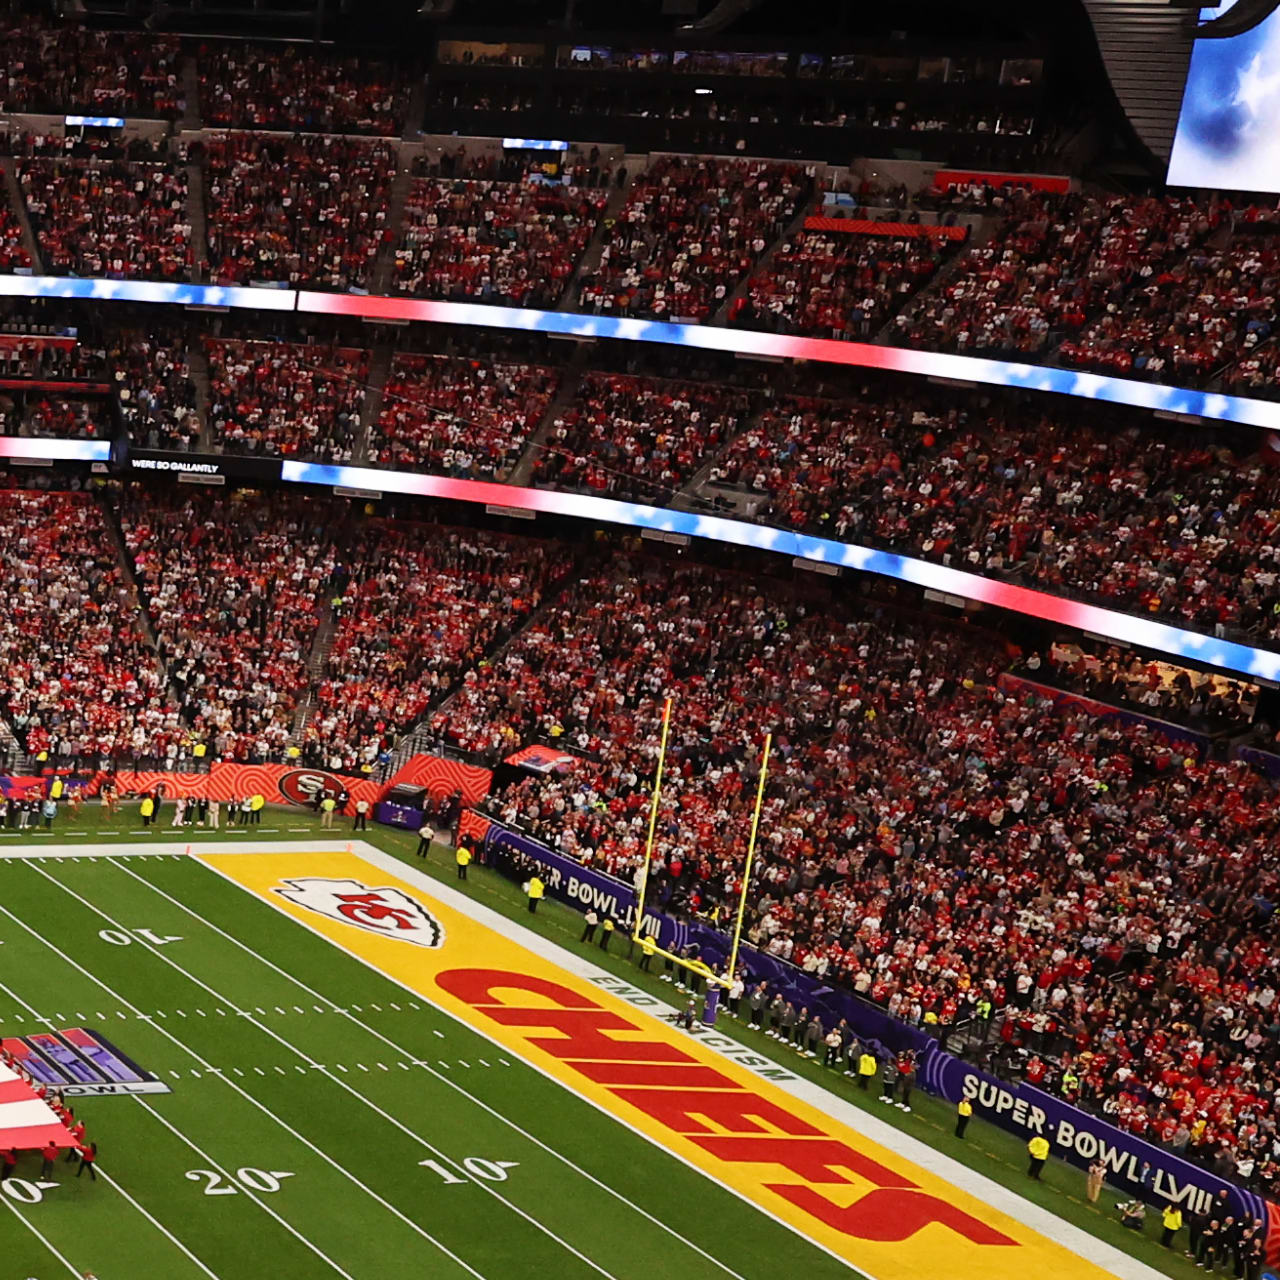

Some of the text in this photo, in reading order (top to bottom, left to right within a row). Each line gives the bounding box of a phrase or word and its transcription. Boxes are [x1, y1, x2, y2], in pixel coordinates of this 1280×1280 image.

[132, 459, 219, 473] WERE SO GALLANTLY
[566, 875, 621, 920] BOWL
[589, 976, 657, 1008] END
[434, 968, 1022, 1247] CHIEFS
[962, 1073, 1215, 1217] SUPER BOWL LVIII
[184, 1167, 285, 1196] 20
[418, 1157, 506, 1185] 10
